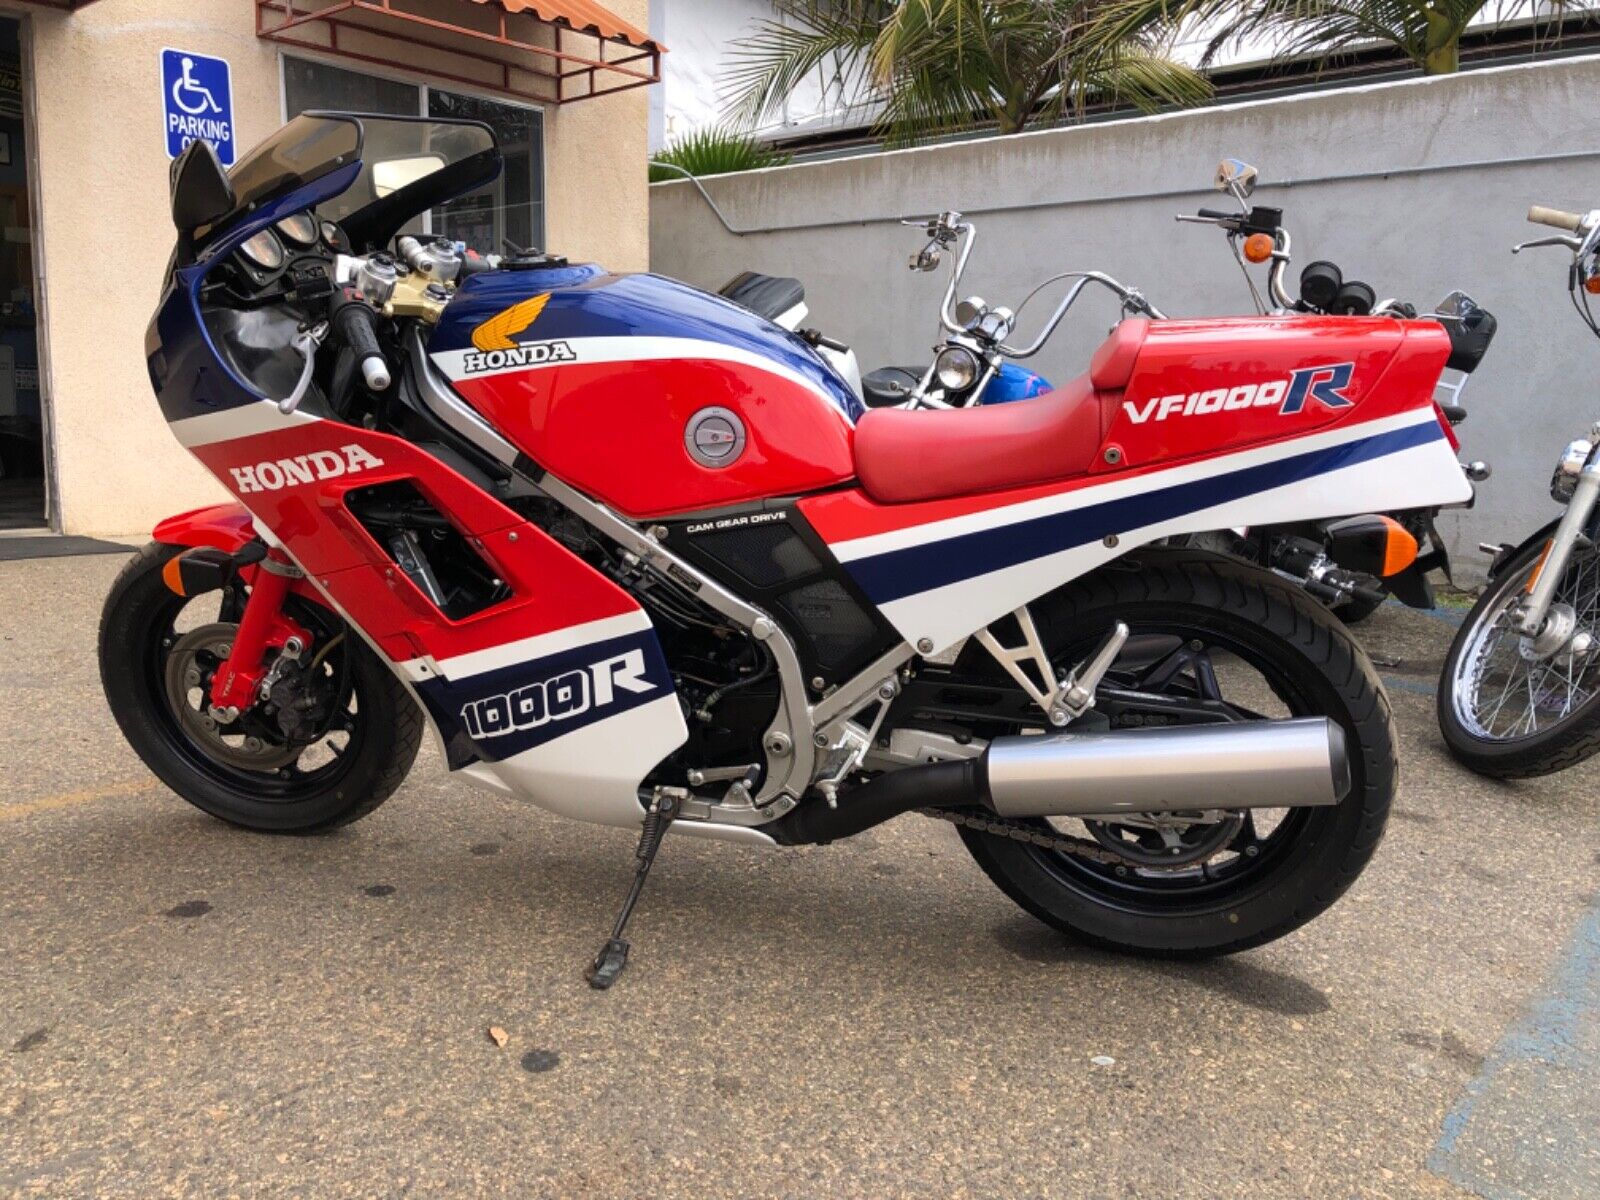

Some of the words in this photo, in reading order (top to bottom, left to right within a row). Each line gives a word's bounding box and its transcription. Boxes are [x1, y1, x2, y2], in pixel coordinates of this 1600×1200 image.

[169, 112, 230, 142] PARKING
[464, 340, 577, 373] HONDA
[1123, 361, 1355, 424] VF1000R
[229, 443, 385, 493] HONDA
[686, 521, 715, 533] CAM
[715, 516, 749, 529] GEAR
[750, 511, 786, 523] DRIVE
[460, 648, 658, 740] 1000R
